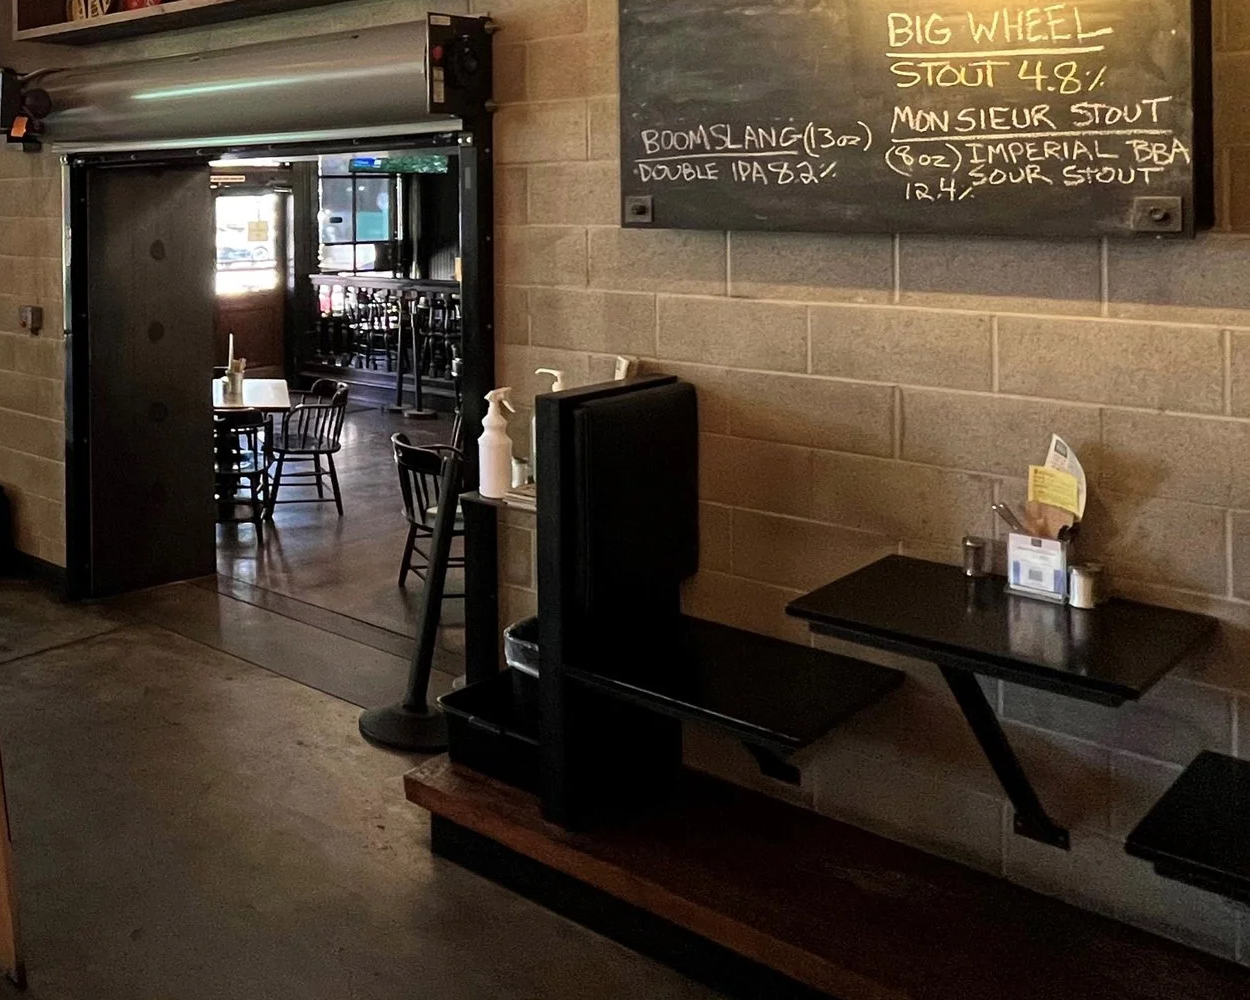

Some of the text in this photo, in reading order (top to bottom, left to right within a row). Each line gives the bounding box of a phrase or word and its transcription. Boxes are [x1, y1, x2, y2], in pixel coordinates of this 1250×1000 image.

[887, 3, 1114, 47] BIG WHEEL
[890, 60, 1108, 94] STOUT 4.8%
[890, 96, 1174, 133] MONSIEUR STOUT
[641, 123, 802, 154] BOOMSLANG
[965, 140, 1119, 163] IMPERIAL
[1125, 138, 1191, 164] BBA
[639, 161, 720, 183] DOUBLE
[732, 160, 768, 185] IPA
[969, 164, 1053, 186] SOUR
[1062, 165, 1166, 187] STOUT
